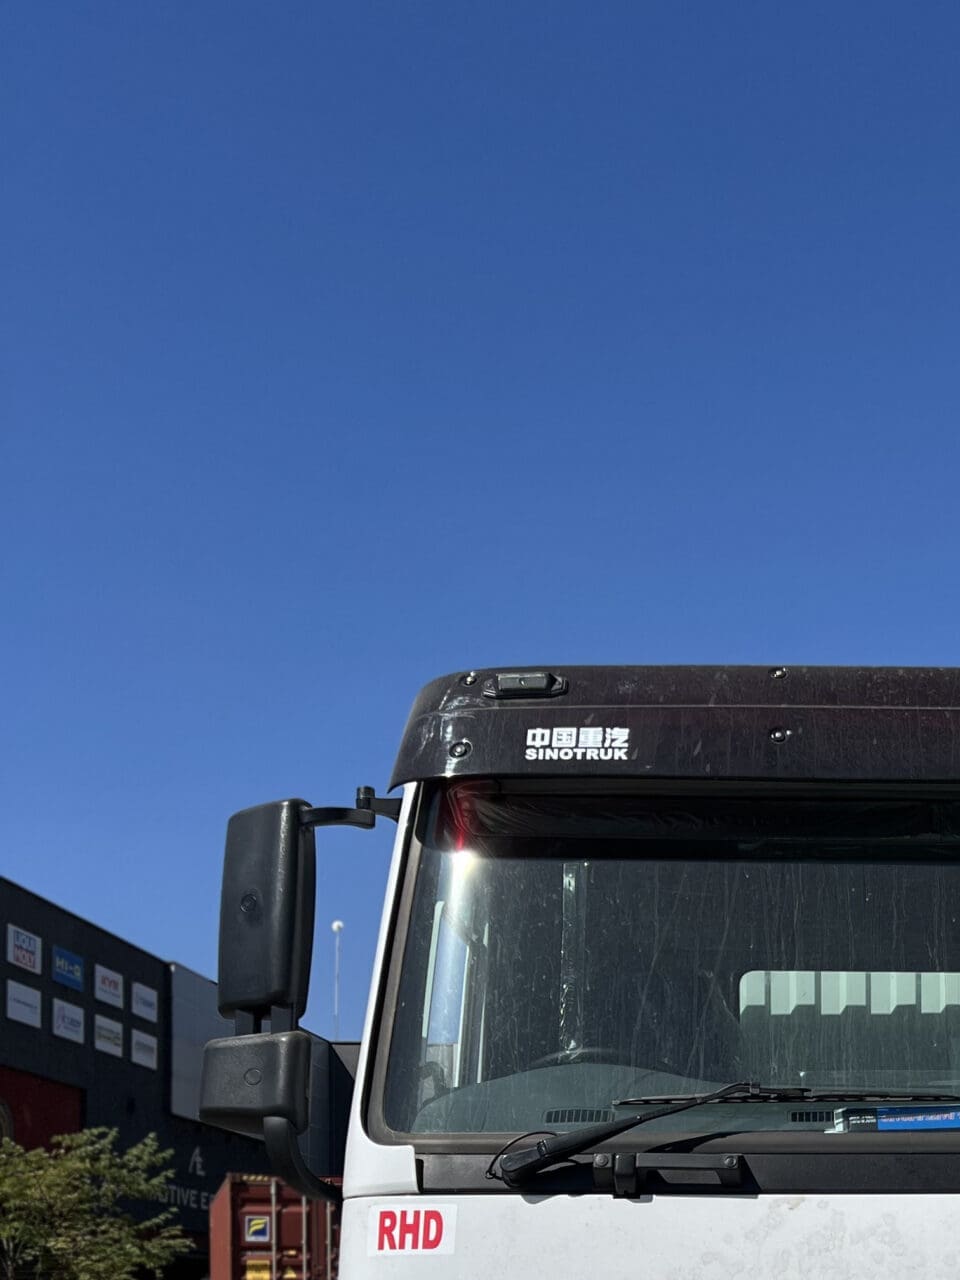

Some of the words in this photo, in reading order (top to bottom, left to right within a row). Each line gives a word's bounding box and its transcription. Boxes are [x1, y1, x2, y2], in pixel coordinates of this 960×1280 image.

[526, 728, 630, 748] 中国重汽
[524, 748, 629, 760] SINOTRUK
[377, 1209, 444, 1250] RHD
